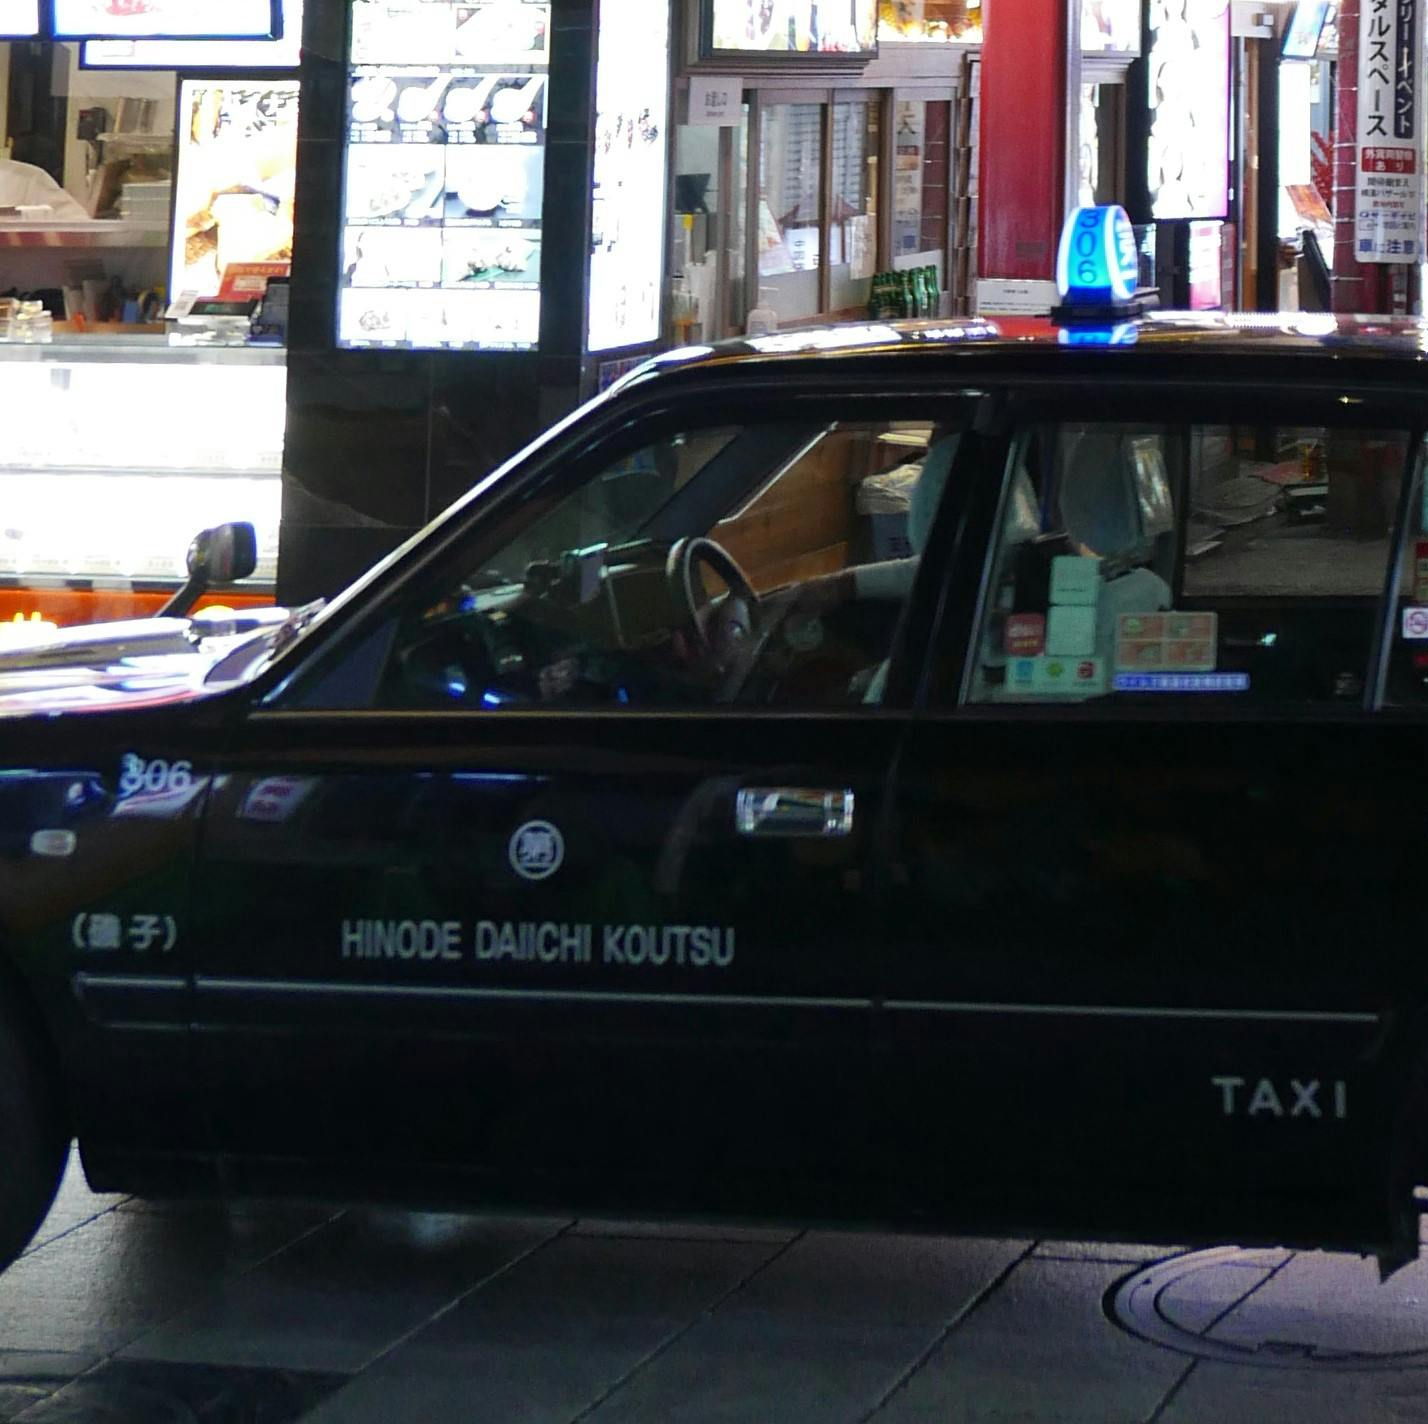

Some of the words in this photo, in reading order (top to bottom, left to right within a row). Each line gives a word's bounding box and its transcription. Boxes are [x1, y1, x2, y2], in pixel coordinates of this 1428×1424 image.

[1076, 210, 1100, 285] 306
[341, 918, 463, 961] HINODE
[475, 920, 593, 963] DAIICHI
[602, 924, 736, 967] KOUTSU
[1211, 1076, 1347, 1118] TAXI
